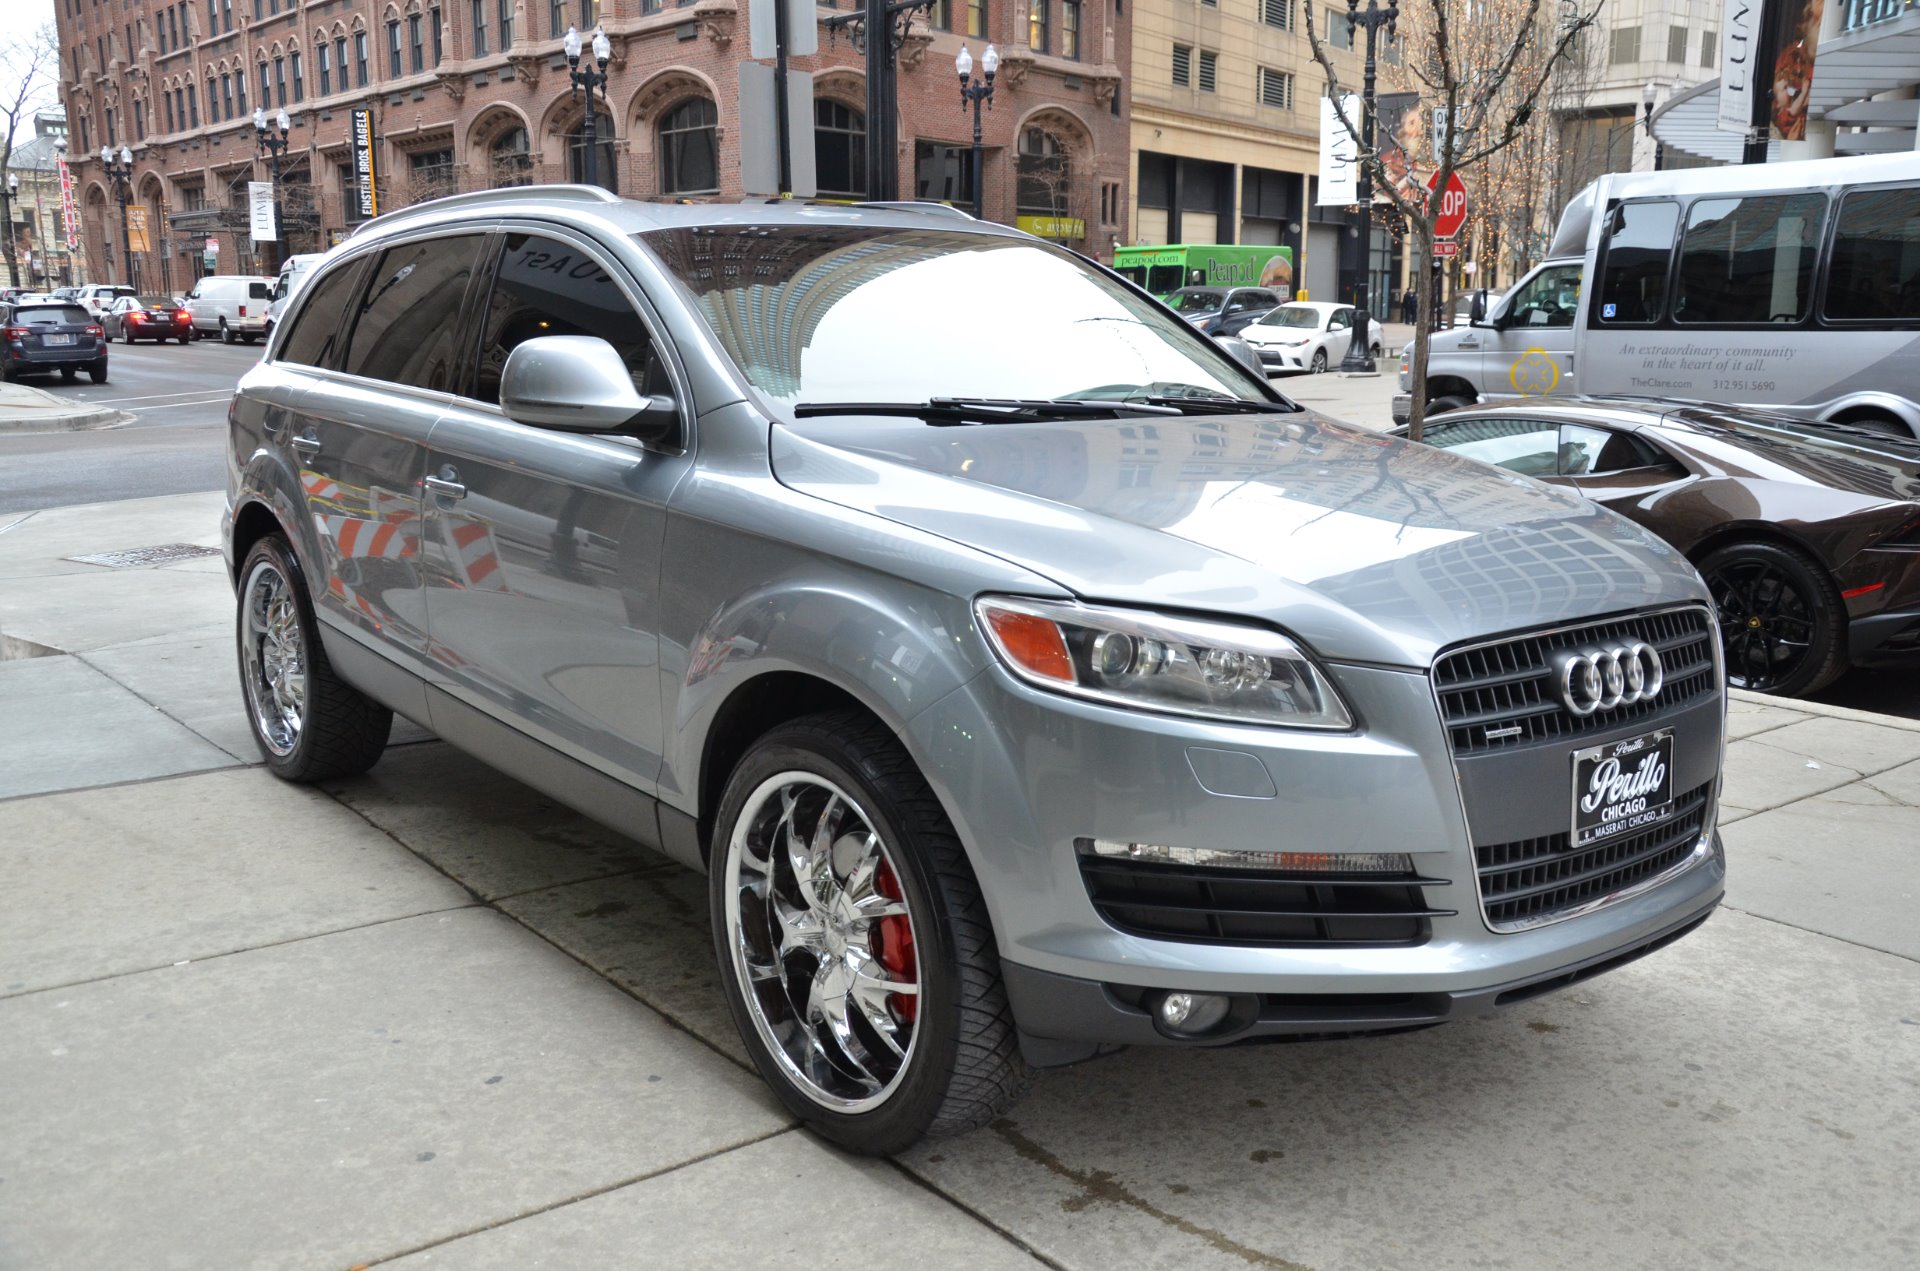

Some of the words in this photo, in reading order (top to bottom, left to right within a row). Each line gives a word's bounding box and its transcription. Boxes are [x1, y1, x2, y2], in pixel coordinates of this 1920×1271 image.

[355, 112, 368, 146] BAGELS
[358, 149, 370, 173] BROS.
[360, 175, 372, 215] EINSTEIN
[1121, 254, 1179, 267] peapod.com
[1434, 245, 1443, 253] ALL
[1445, 245, 1455, 253] WAY
[1208, 256, 1254, 286] Peapod
[1618, 343, 1636, 355] An
[1638, 343, 1722, 360] extraordinary
[1725, 345, 1797, 361] community
[1642, 357, 1655, 369] in
[1658, 357, 1677, 369] the
[1680, 357, 1713, 370] heart
[1716, 358, 1730, 374] of
[1732, 359, 1743, 371] it
[1745, 359, 1766, 372] all.
[1630, 377, 1693, 389] TheClare.com
[1712, 379, 1776, 391] 312.951.5690
[1612, 738, 1645, 757] Perillo
[1581, 751, 1665, 813] Perillo
[1601, 797, 1646, 822] CHICAGO
[1595, 819, 1627, 839] MASERATI
[1628, 810, 1656, 828] CHICAGO
